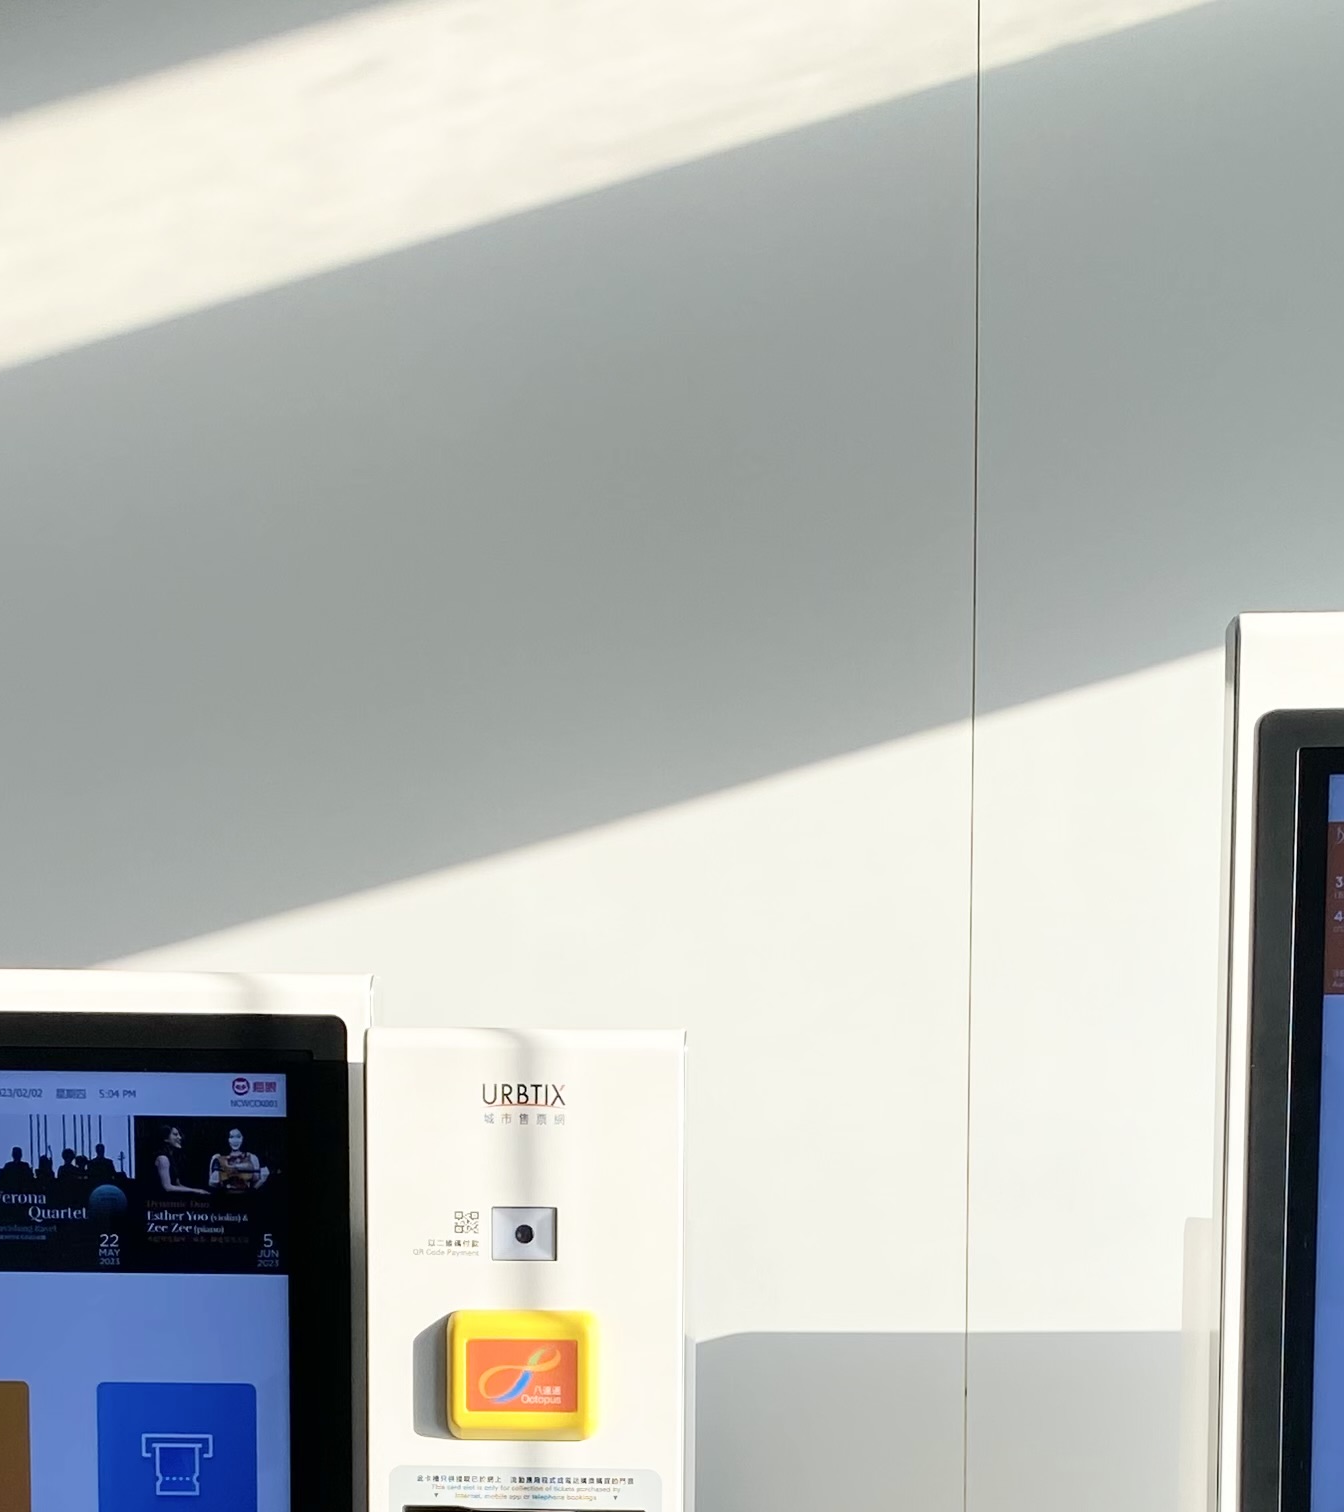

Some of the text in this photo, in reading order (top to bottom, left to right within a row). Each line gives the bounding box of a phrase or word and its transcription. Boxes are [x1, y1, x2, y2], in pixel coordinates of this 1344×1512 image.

[99, 1088, 137, 1099] 5:04 PM
[481, 1083, 567, 1107] URBTIX
[28, 1205, 89, 1222] Quartet
[146, 1210, 184, 1221] Esther
[185, 1210, 209, 1221] Yoo
[210, 1213, 241, 1223] (violin)
[146, 1222, 225, 1235] Zee Zee (piano)
[99, 1233, 120, 1248] 22
[262, 1233, 273, 1248] 5
[98, 1248, 121, 1257] MAY
[256, 1249, 280, 1258] JUN
[412, 1248, 424, 1256] QR
[425, 1248, 445, 1256] Code
[98, 1257, 121, 1266] 2023
[520, 1395, 562, 1406] Octopus
